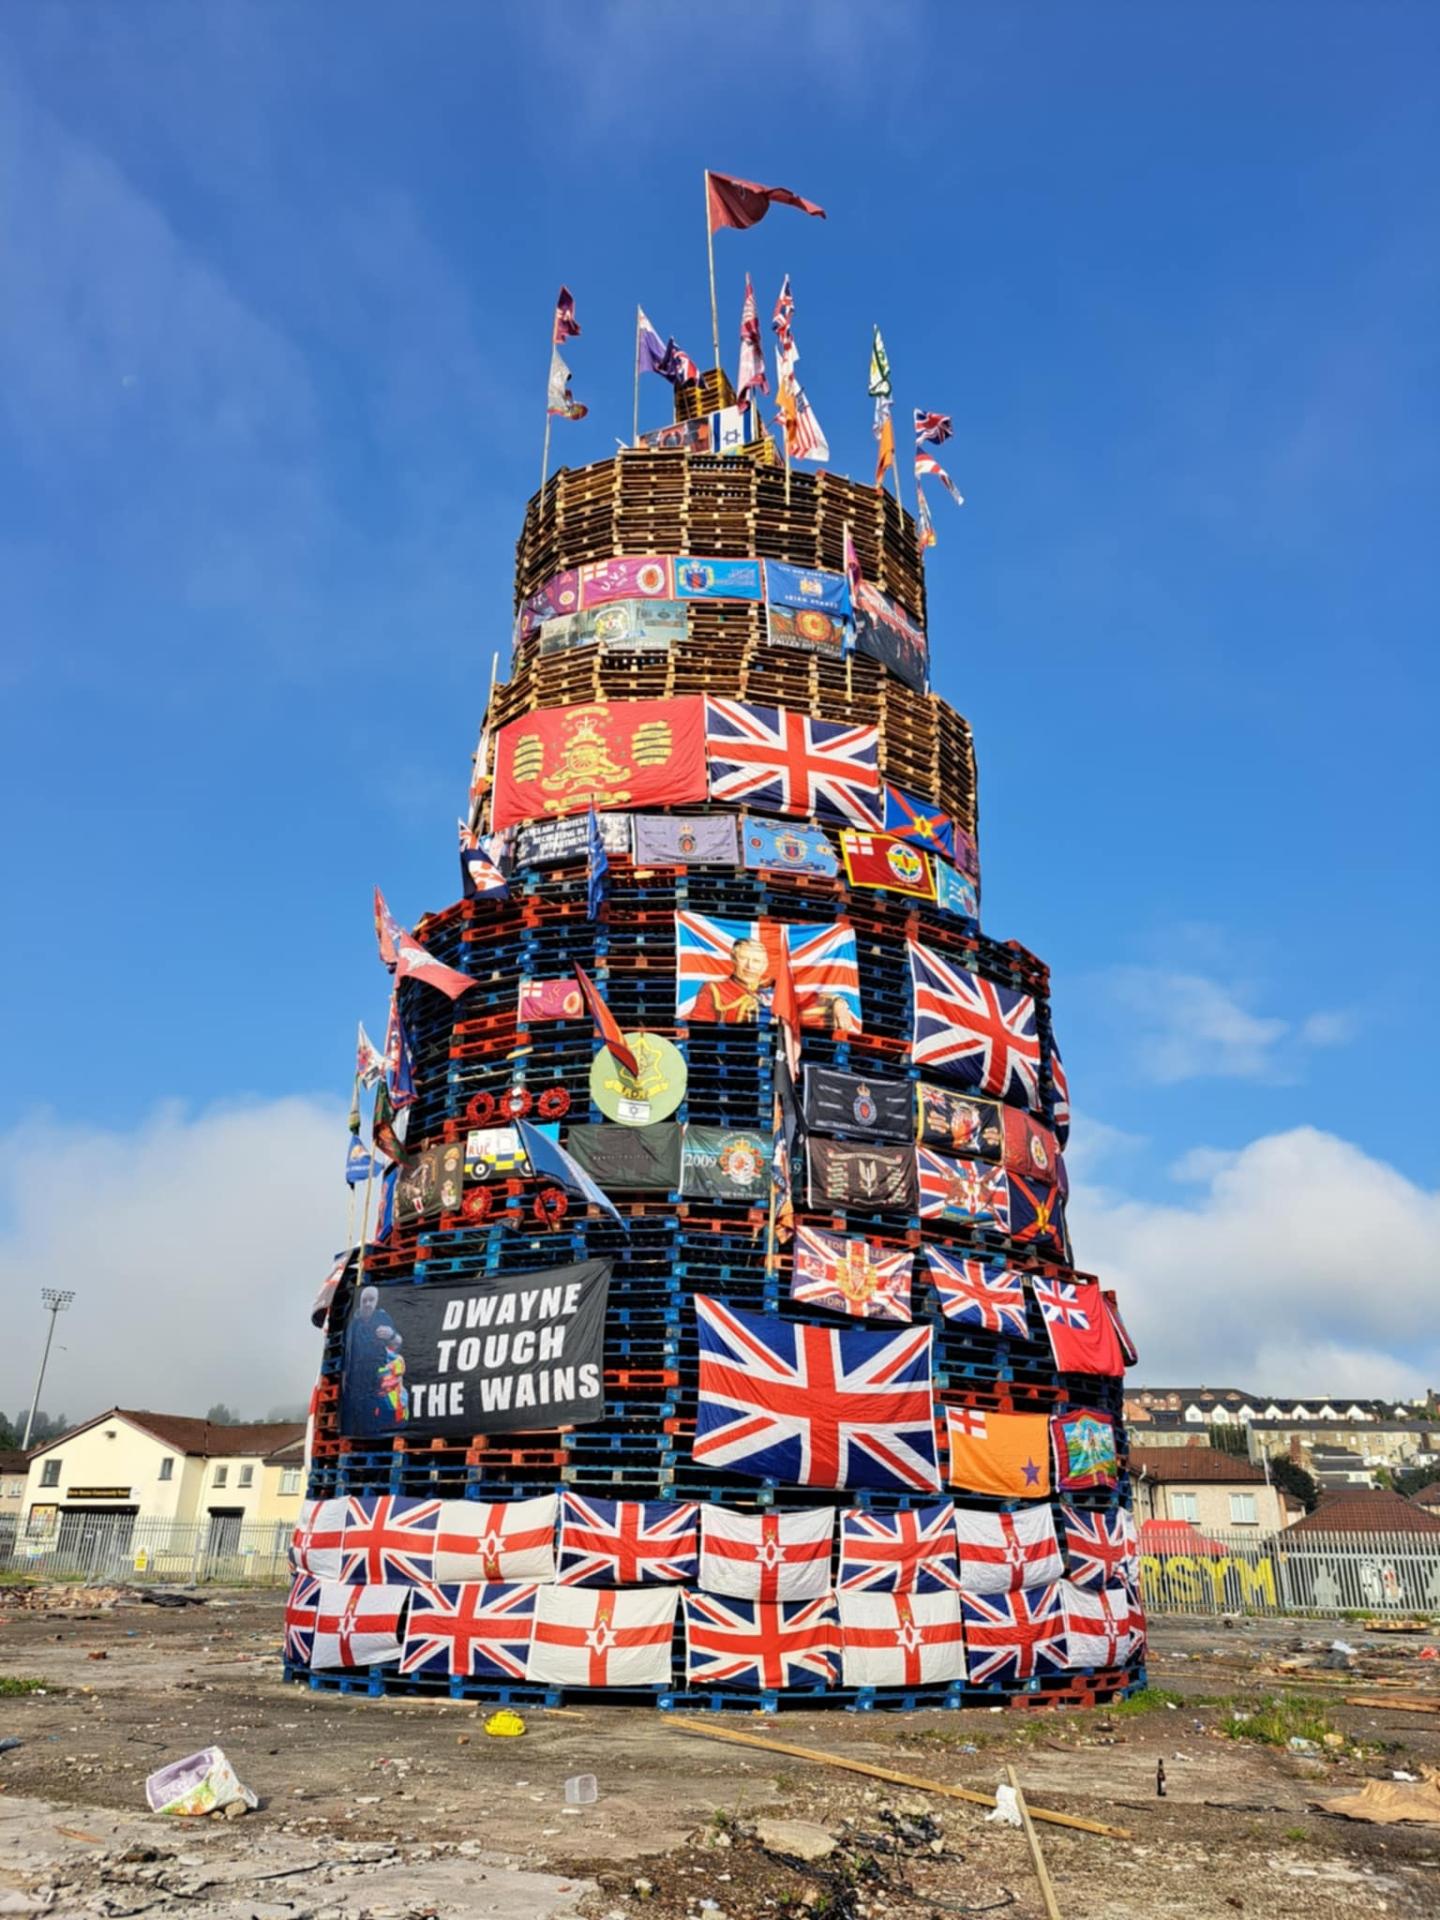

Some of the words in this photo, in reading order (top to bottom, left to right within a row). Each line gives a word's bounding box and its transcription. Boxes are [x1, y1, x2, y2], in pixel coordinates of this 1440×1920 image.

[684, 1153, 717, 1168] 2009
[442, 1283, 582, 1331] DWAYNE
[437, 1325, 566, 1373] TOUCH
[411, 1381, 465, 1418] THE
[480, 1363, 600, 1413] WAINS
